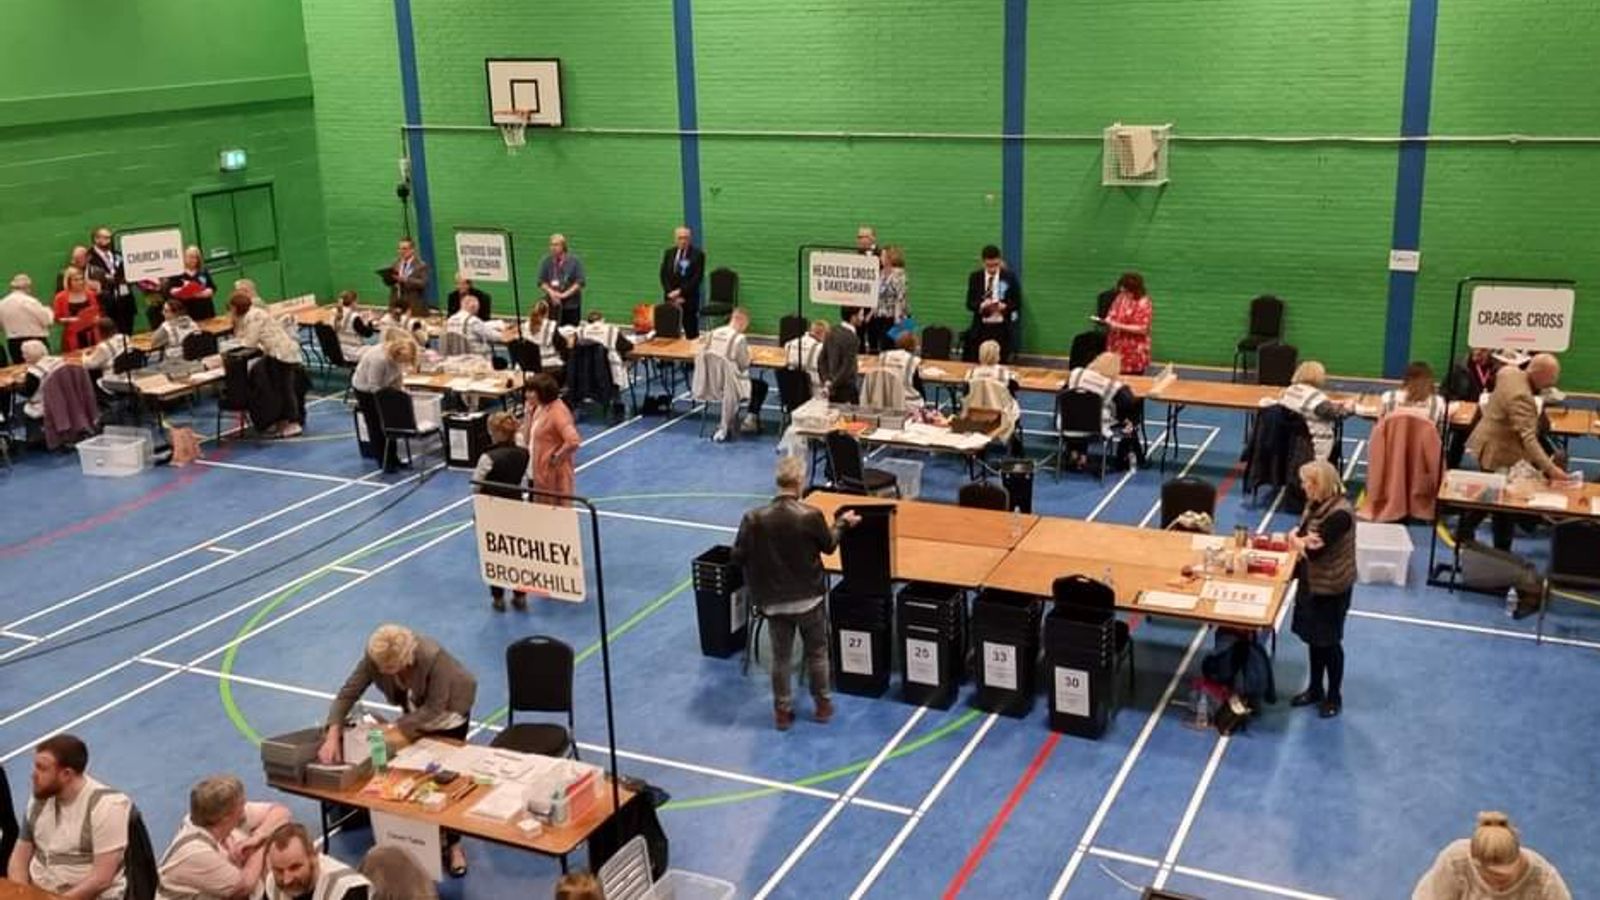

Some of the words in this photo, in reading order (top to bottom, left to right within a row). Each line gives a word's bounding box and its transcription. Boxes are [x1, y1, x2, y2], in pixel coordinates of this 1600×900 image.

[813, 264, 850, 278] HEADLESS
[852, 266, 877, 281] CROSS
[1478, 310, 1522, 327] CRABBS
[1526, 312, 1564, 329] CROSS
[485, 531, 571, 565] BATCHLEY
[485, 562, 582, 595] BROCKHILL
[849, 637, 863, 648] 27
[1064, 675, 1080, 688] 30
